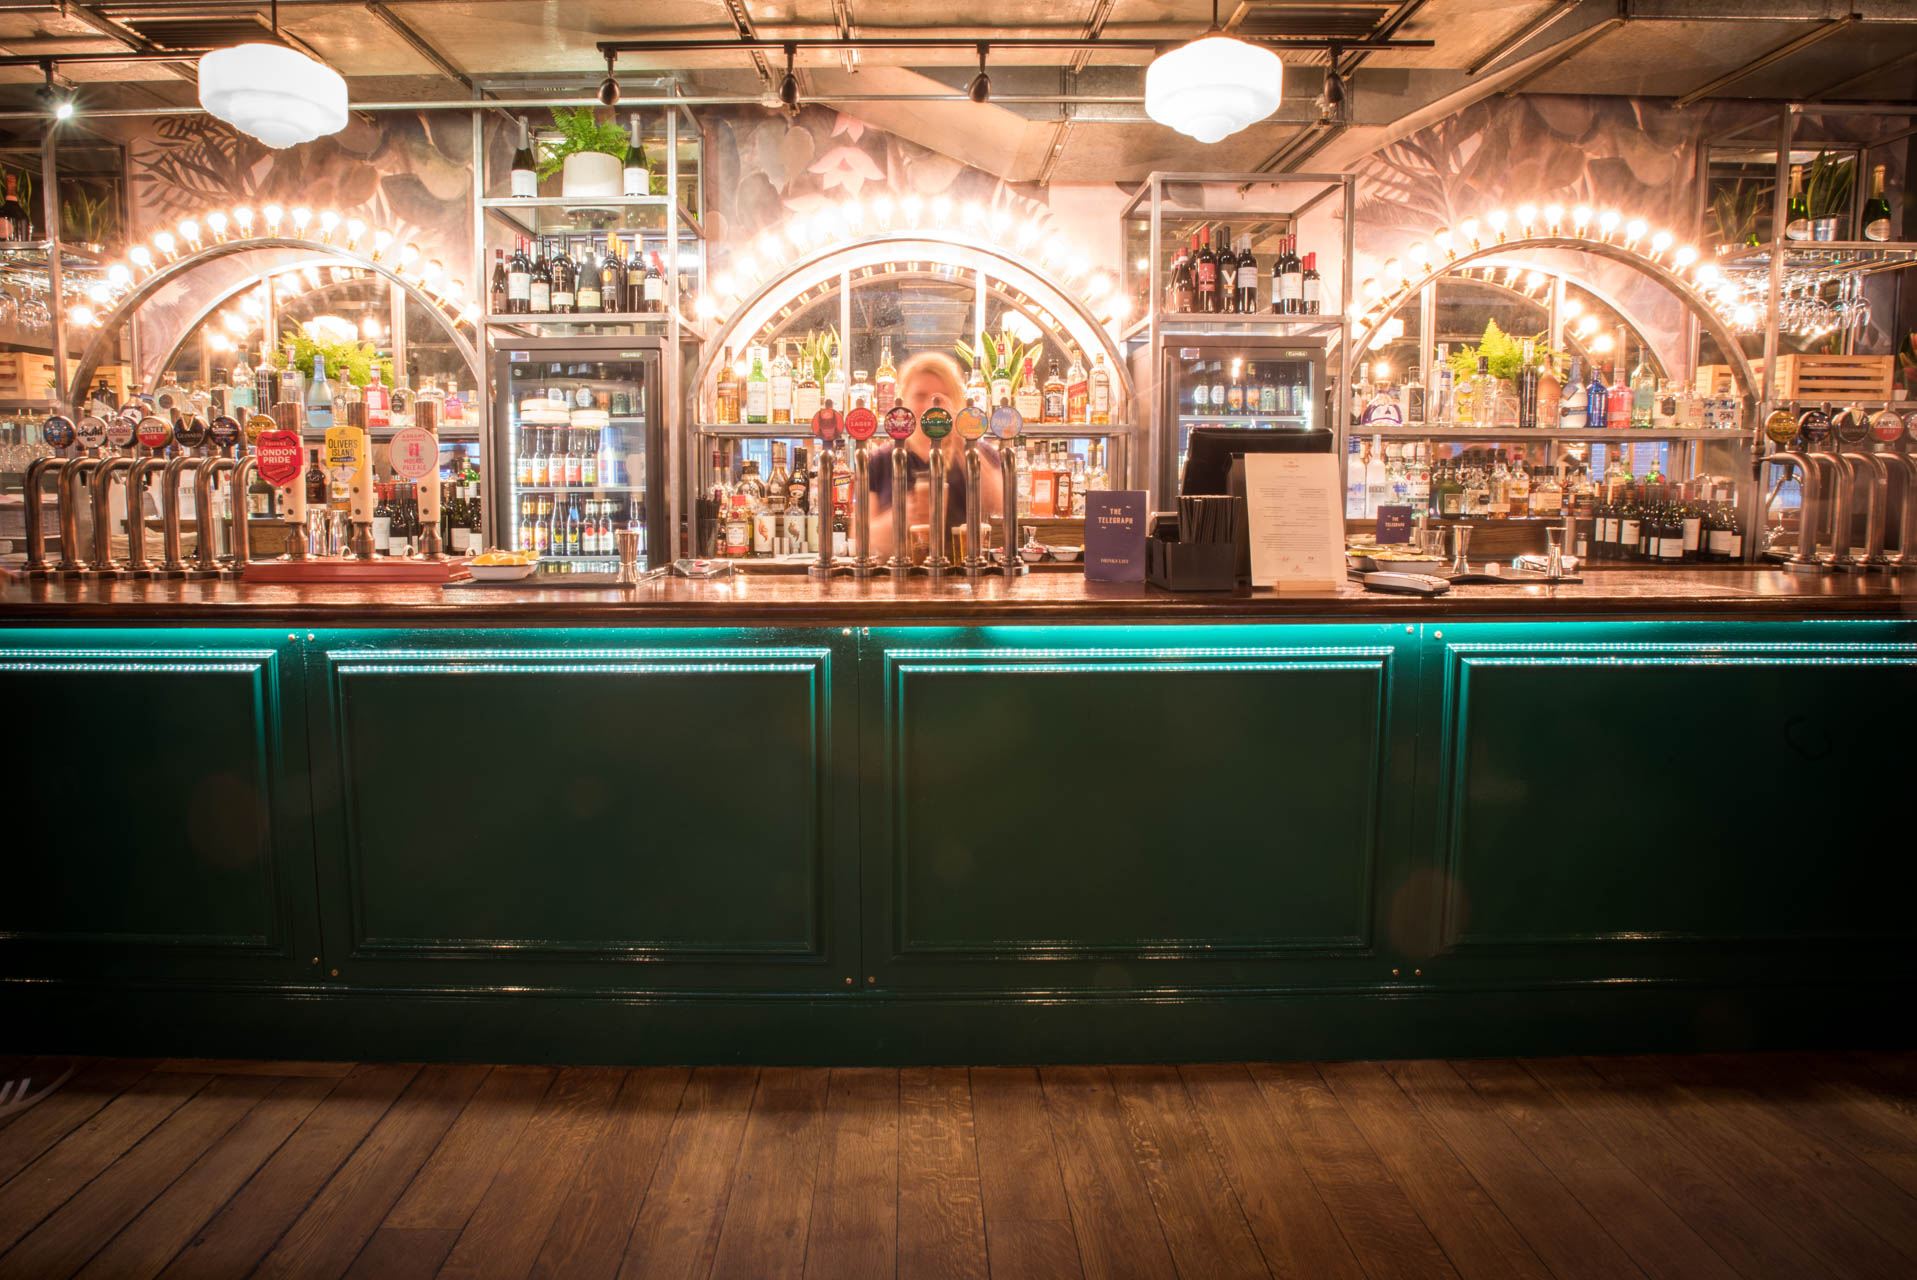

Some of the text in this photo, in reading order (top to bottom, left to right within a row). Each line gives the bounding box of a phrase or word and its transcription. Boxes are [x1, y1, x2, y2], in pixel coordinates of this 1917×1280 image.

[258, 448, 297, 457] LONDON
[331, 448, 355, 456] ISLAND
[263, 456, 291, 464] PRIDE
[1098, 517, 1134, 525] TELEGRAPH
